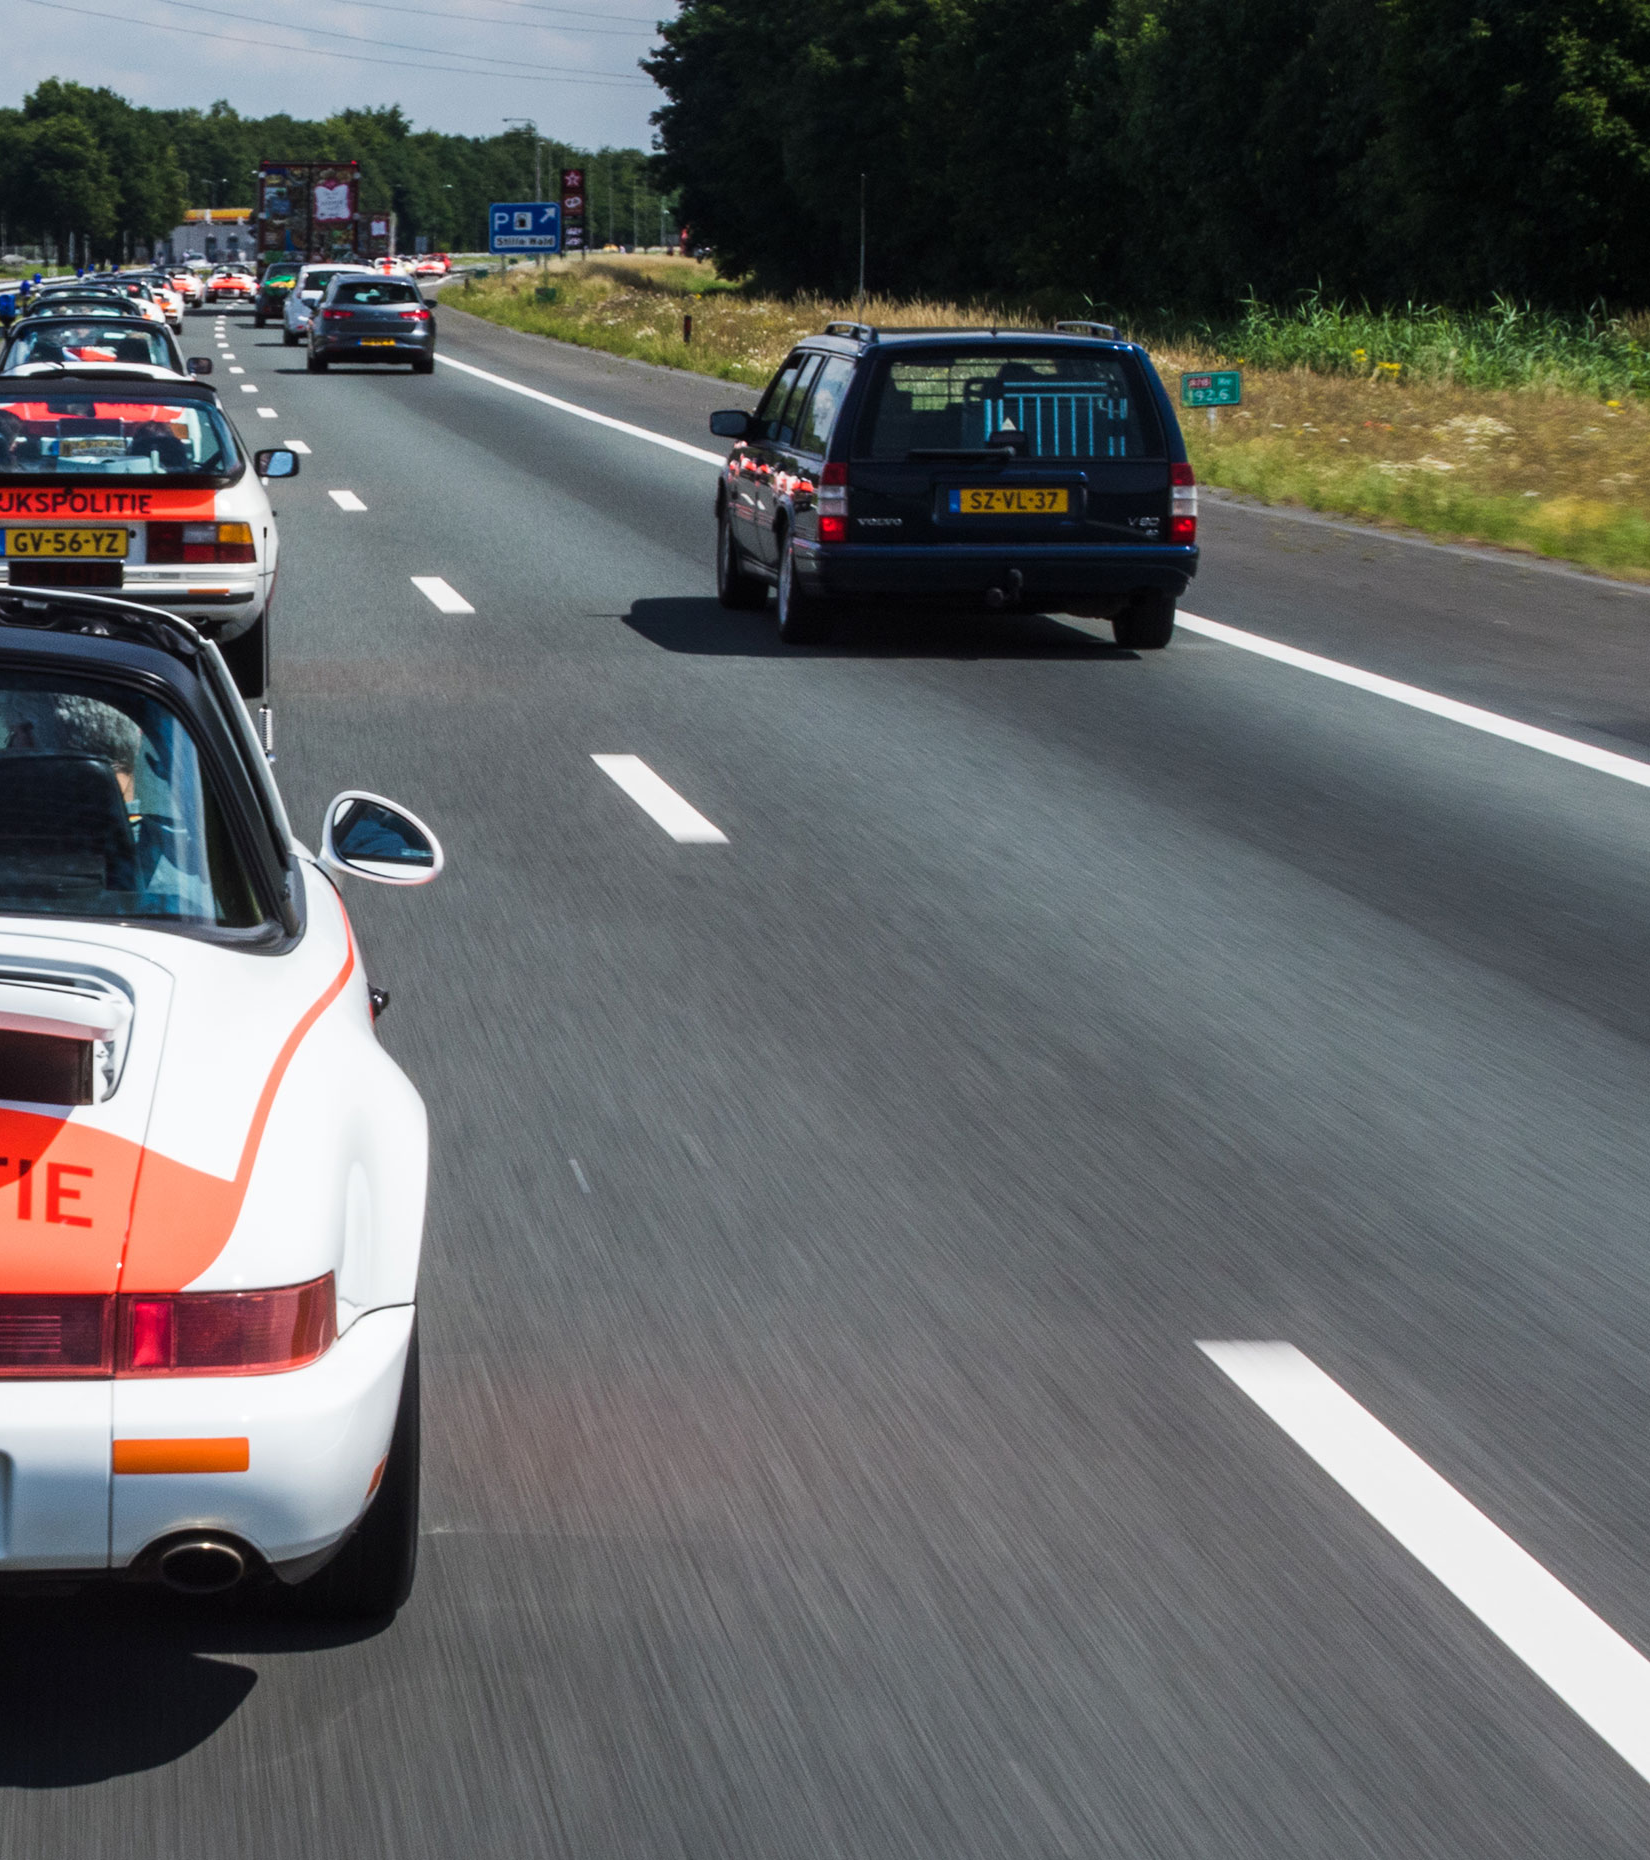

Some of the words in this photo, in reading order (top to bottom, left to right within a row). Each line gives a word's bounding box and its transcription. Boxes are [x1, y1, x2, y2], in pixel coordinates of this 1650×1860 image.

[494, 212, 509, 231] P
[970, 491, 1059, 510] SZ-VL-37
[857, 517, 903, 526] VOLVO
[13, 532, 119, 553] GV-56-YZ
